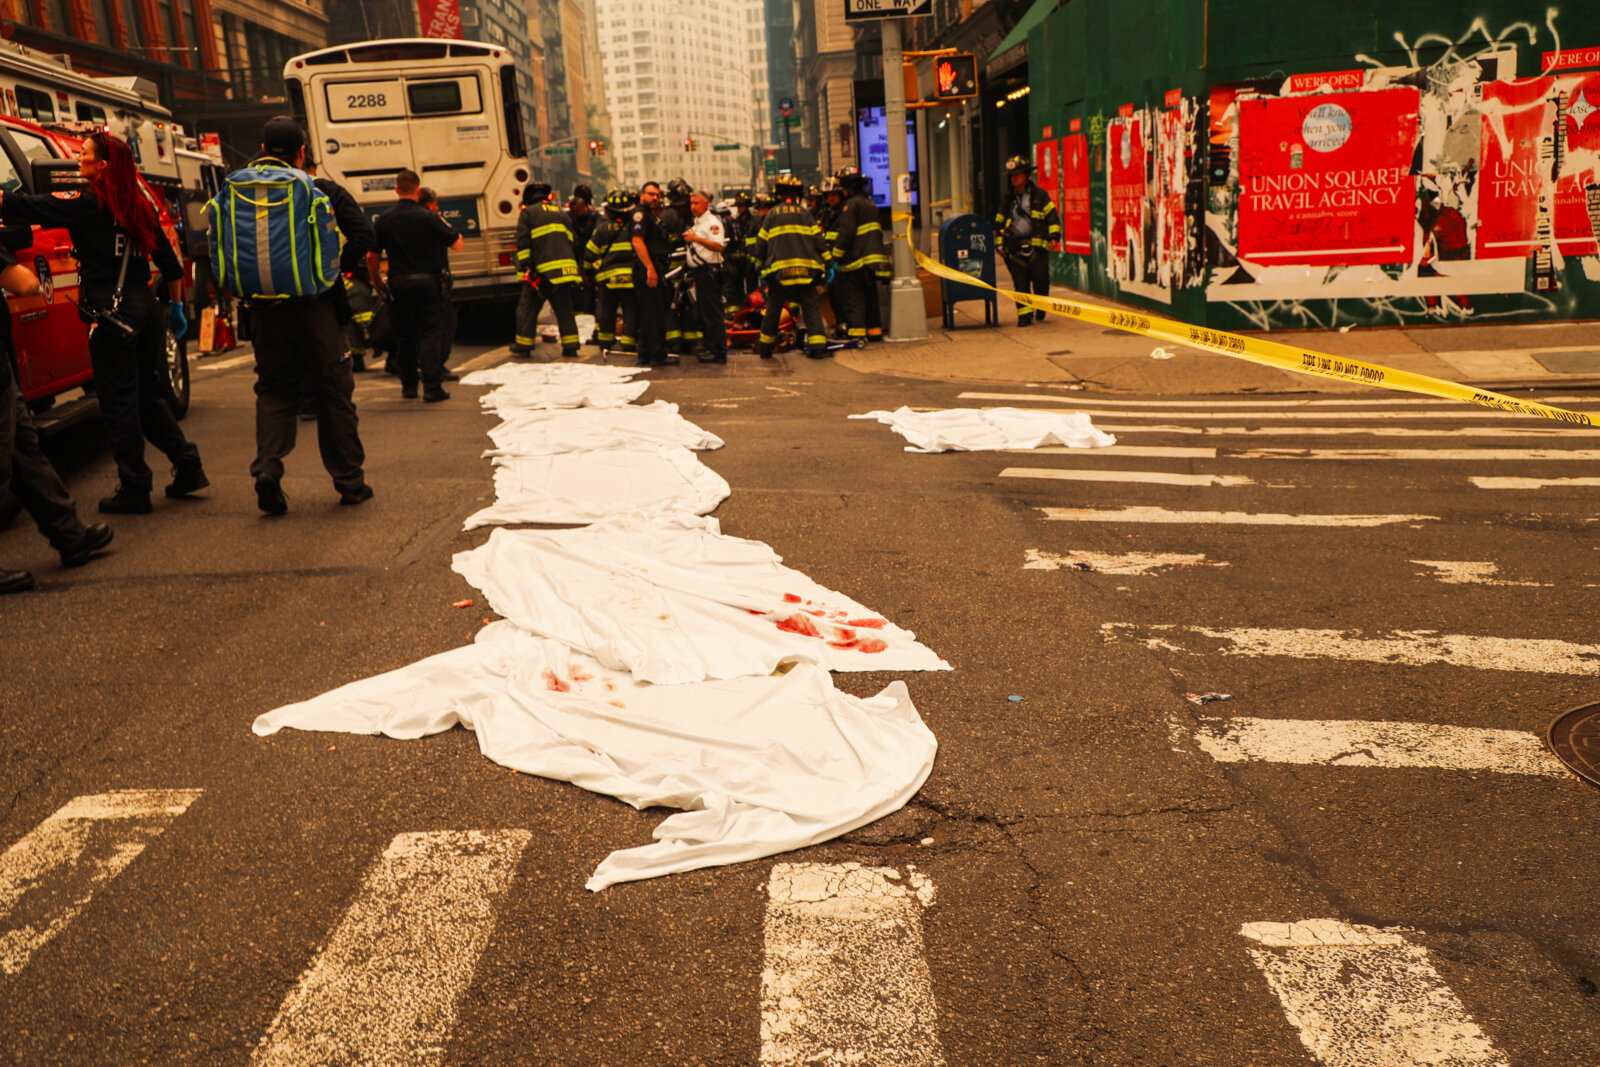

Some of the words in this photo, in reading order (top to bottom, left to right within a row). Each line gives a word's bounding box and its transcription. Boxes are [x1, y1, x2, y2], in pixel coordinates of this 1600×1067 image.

[856, 0, 881, 10] ONE
[1328, 73, 1360, 86] OPEN
[347, 94, 387, 108] 2288
[373, 139, 387, 148] City
[1495, 159, 1541, 178] UNI
[1252, 172, 1319, 193] UNION
[1325, 168, 1399, 189] SQUARE
[1250, 192, 1314, 211] TRAVEL
[1318, 187, 1401, 208] AGENCY
[1296, 210, 1334, 219] cannabis
